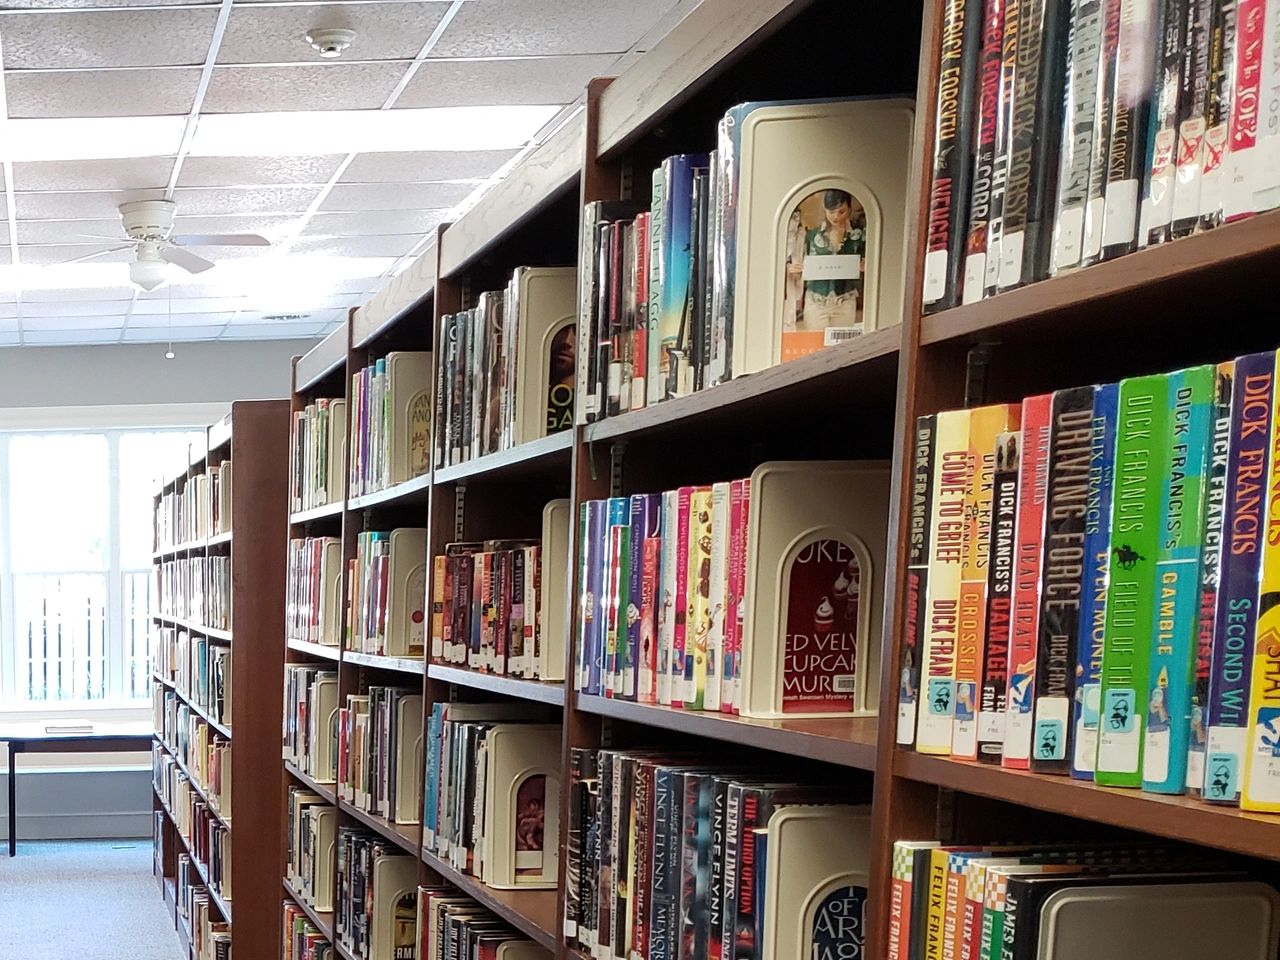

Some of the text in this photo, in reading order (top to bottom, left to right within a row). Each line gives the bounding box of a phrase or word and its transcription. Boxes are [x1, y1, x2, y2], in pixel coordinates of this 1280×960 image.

[1234, 84, 1259, 142] JOE?
[652, 183, 663, 262] FANNIE
[917, 428, 932, 468] DICK
[1033, 456, 1049, 506] FRANCIS
[1119, 394, 1154, 534] DICK FRANCIS
[1165, 387, 1193, 550] DICK FRANCIS'S
[1231, 372, 1272, 557] DICK FRANCIS
[935, 450, 968, 565] COME TO GRIEF
[975, 499, 994, 570] FRANCIS
[1045, 410, 1094, 612] DRIVING FORCE
[1086, 465, 1104, 536] FRANCIS
[1202, 418, 1232, 586] DICK FRANCIS'S
[994, 481, 1016, 594] DICK FRANCIS'S
[1019, 542, 1038, 592] DEAD
[931, 600, 957, 634] DICK
[986, 596, 1011, 682] DAMAGE
[1088, 609, 1107, 681] MONEY
[1110, 581, 1140, 656] FIELD OF
[1156, 571, 1179, 657] GAMBLE
[1195, 589, 1217, 679] REFUSAL
[1222, 598, 1253, 684] SECOND
[611, 806, 619, 849] FLYNN
[638, 830, 647, 884] FLYNN
[654, 775, 669, 891] VINCE FLYNN
[710, 793, 724, 926] VINCE FLYNN
[725, 797, 739, 901] TERM LIMITS
[740, 865, 756, 914] OPTION
[890, 883, 903, 918] FELIX
[930, 865, 944, 910] FELIX
[945, 876, 959, 914] FELIX
[961, 903, 974, 942] FELIX
[1003, 892, 1019, 944] JAMES
[979, 913, 994, 951] FELIX
